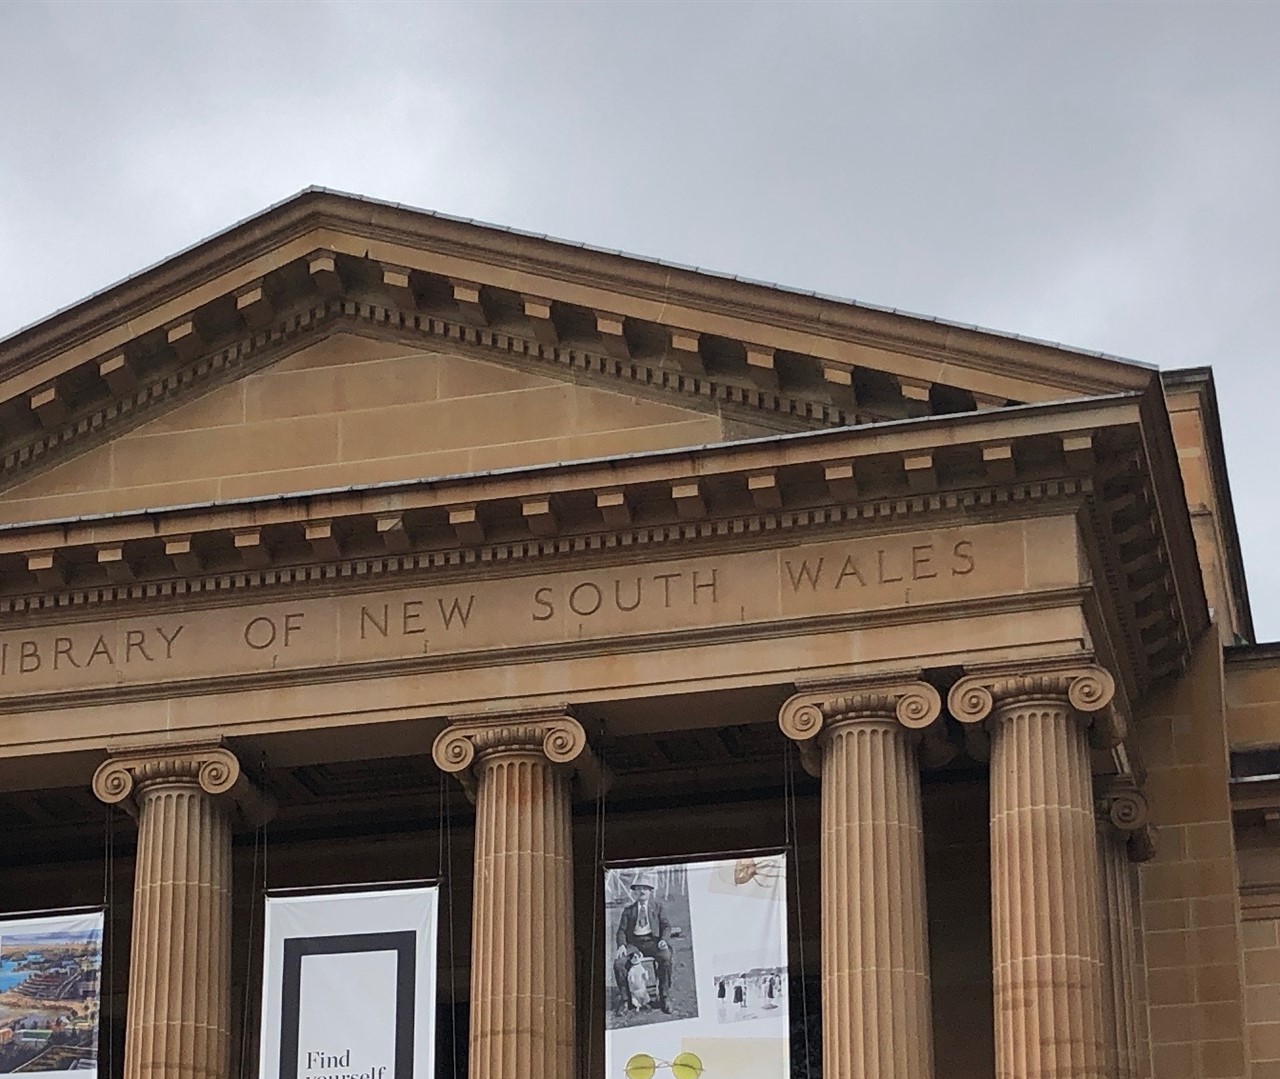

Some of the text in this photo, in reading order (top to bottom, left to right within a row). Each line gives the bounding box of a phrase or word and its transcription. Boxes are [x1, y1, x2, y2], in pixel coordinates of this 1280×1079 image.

[244, 612, 305, 650] OF
[359, 594, 476, 640] NEW
[531, 567, 720, 622] SOUTH
[784, 539, 976, 593] WALES
[306, 1049, 351, 1069] Find
